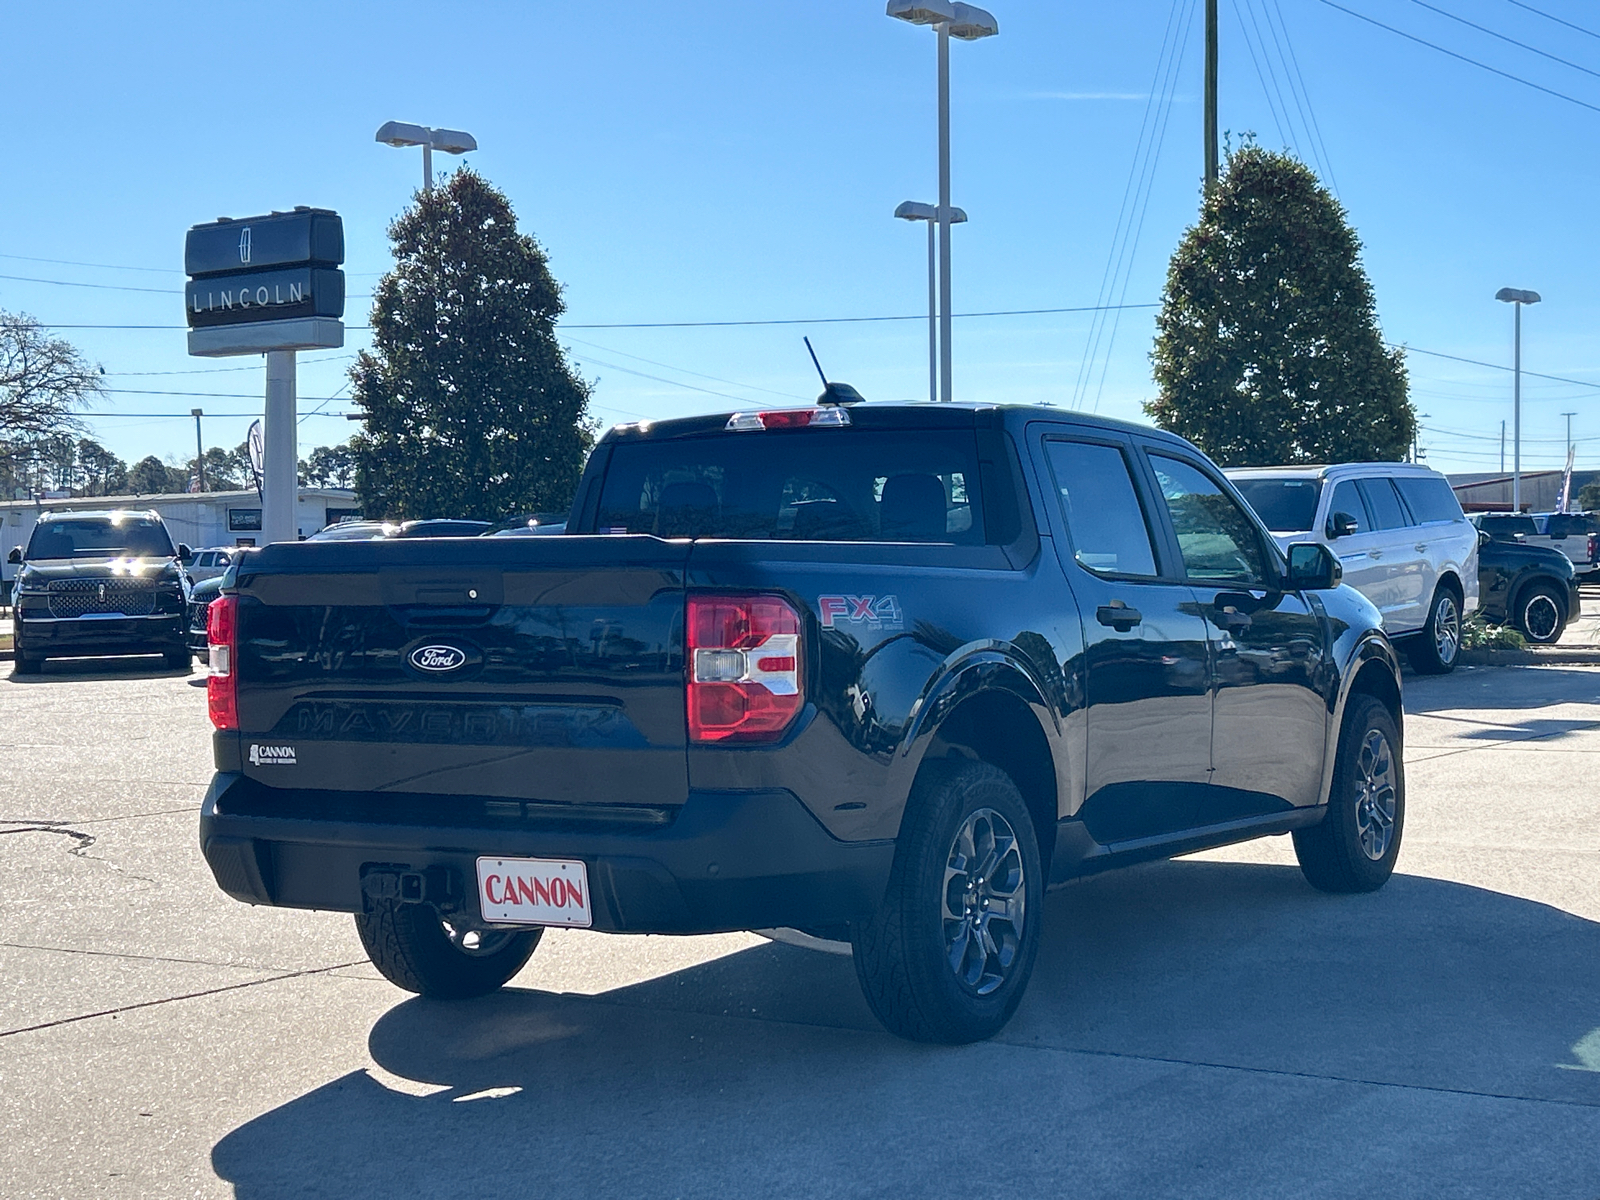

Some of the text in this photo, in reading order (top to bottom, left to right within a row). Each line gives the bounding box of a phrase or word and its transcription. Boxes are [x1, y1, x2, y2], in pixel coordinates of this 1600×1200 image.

[194, 282, 302, 313] LINCOLN
[817, 594, 904, 631] FX4
[421, 648, 455, 666] Ford
[259, 745, 296, 758] CANNON
[485, 874, 584, 909] CANNON
